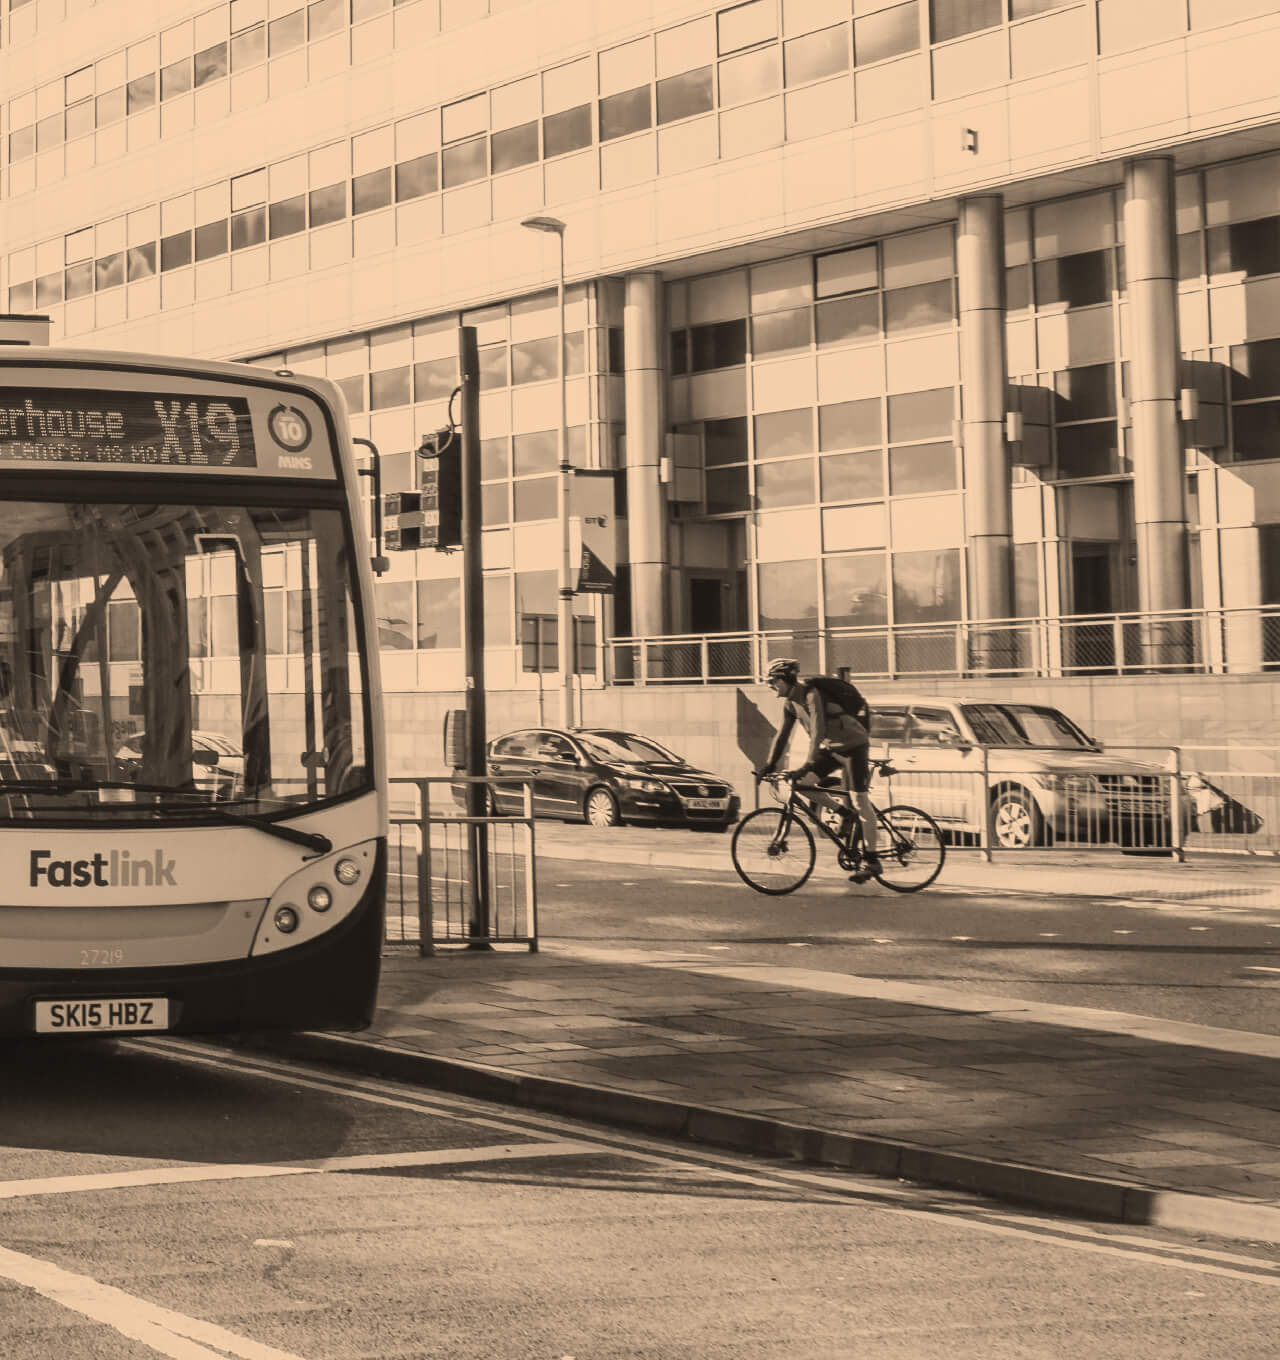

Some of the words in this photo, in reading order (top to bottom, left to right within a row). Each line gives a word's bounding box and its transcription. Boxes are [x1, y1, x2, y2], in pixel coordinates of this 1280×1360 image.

[153, 399, 242, 465] X19
[278, 421, 303, 441] 10
[277, 455, 313, 470] MINS
[29, 848, 178, 888] Fastlink
[79, 948, 124, 966] 27219
[50, 1003, 102, 1029] SK15
[109, 1002, 154, 1027] HBZ
